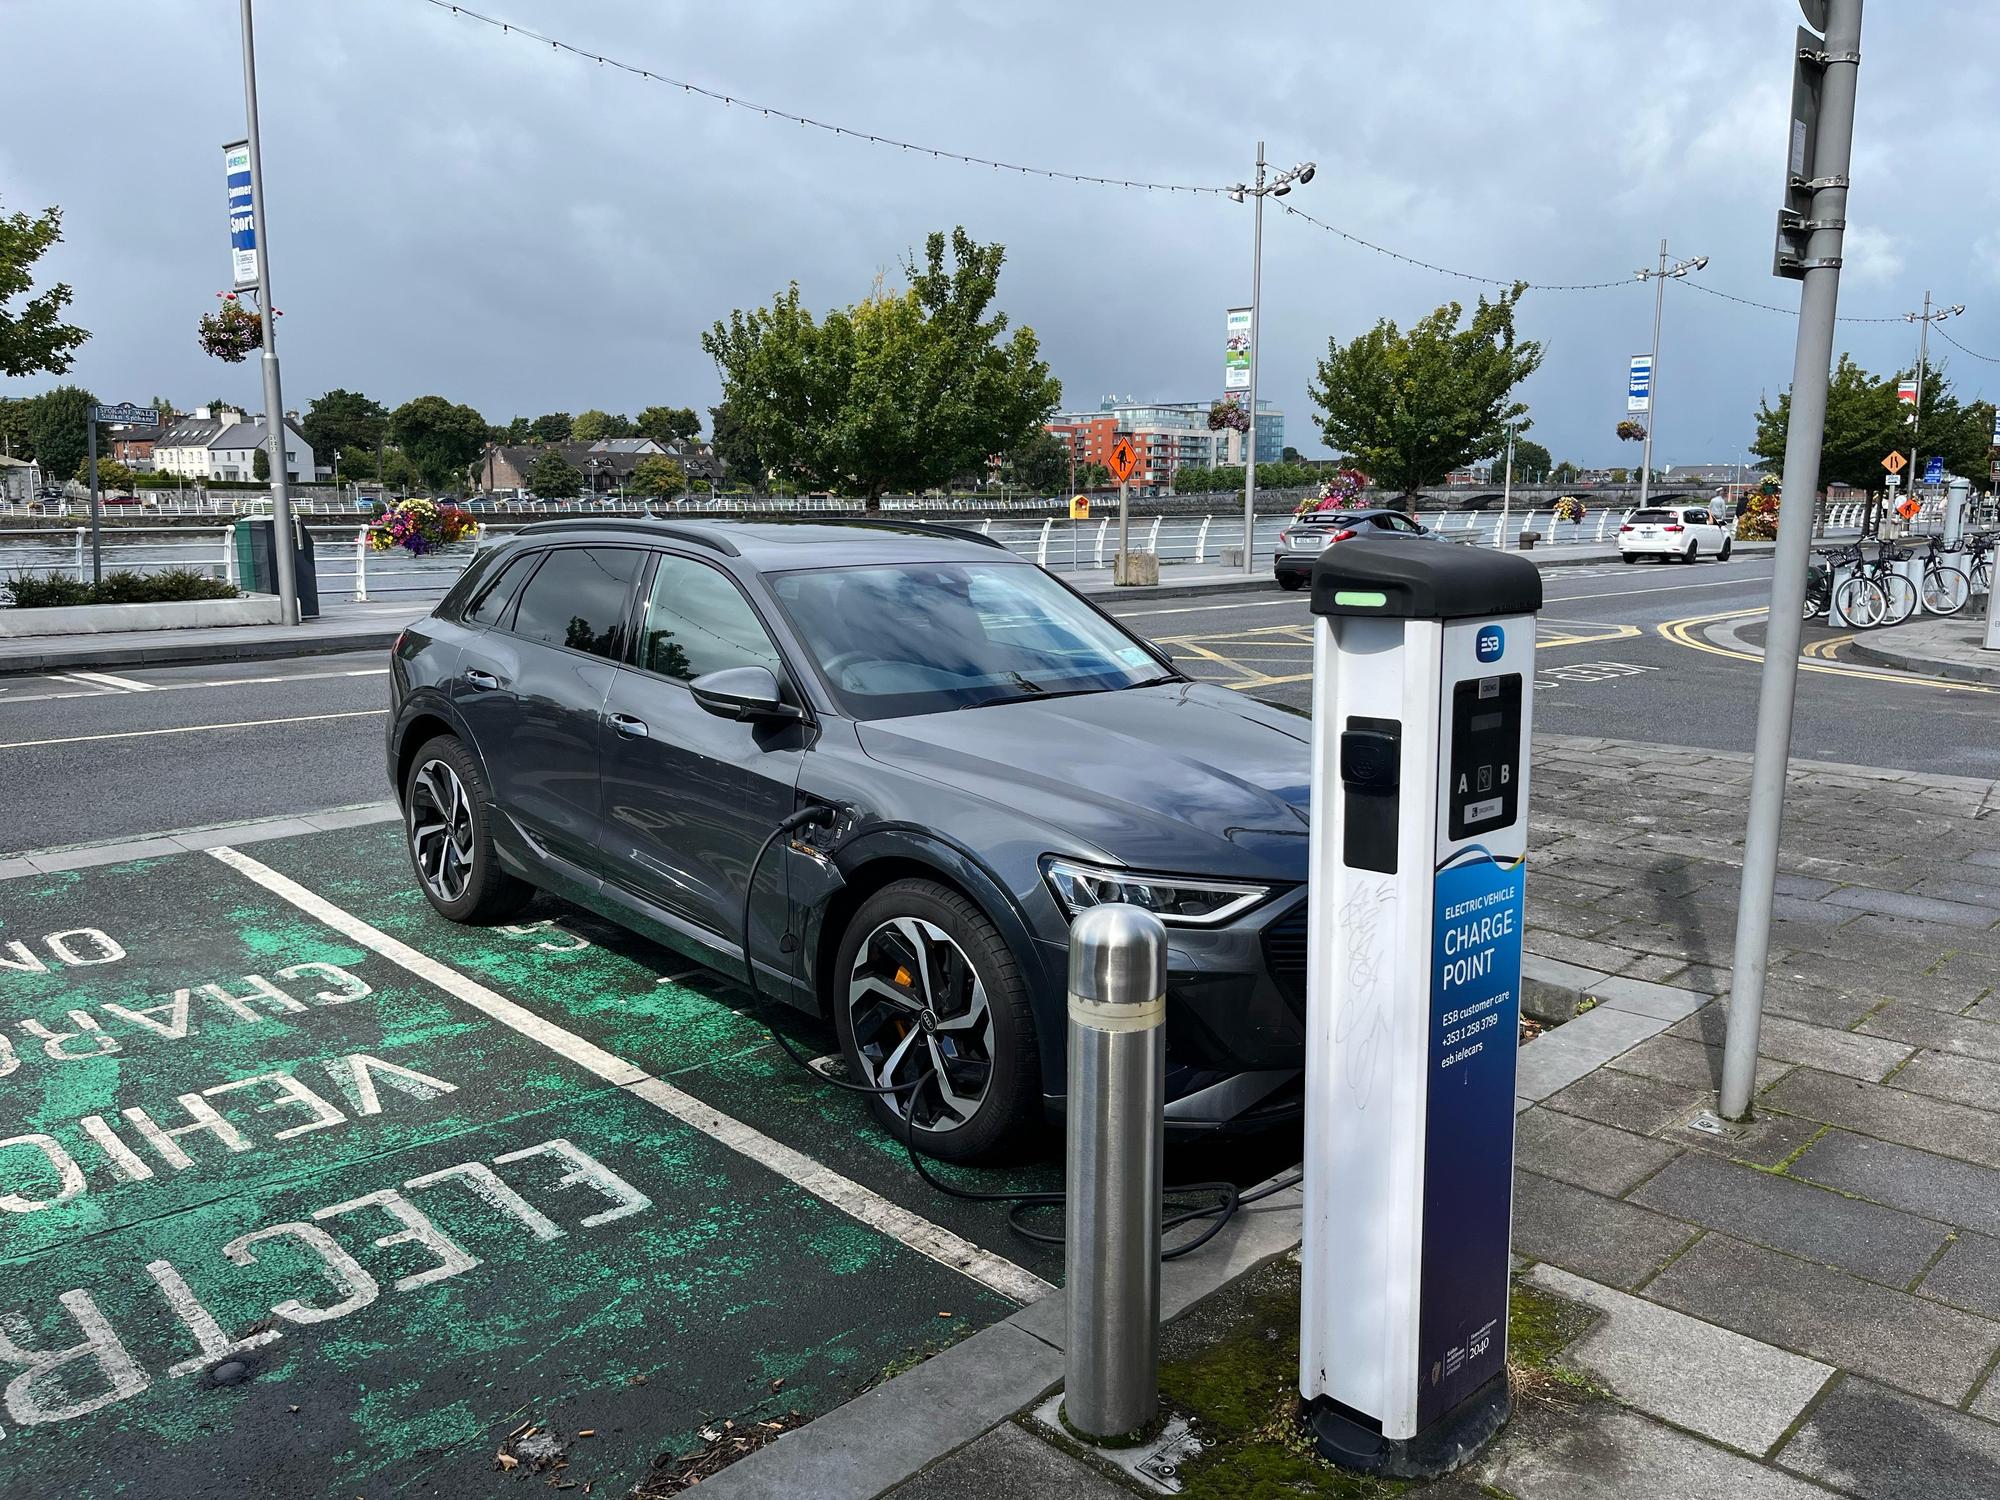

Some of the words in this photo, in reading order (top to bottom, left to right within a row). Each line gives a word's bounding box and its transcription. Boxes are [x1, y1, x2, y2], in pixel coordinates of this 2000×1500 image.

[231, 215, 254, 234] Sport
[1481, 636, 1499, 652] ESB
[1458, 774, 1468, 794] A
[1500, 764, 1510, 784] B
[1445, 896, 1483, 920] ELECTRIC
[1483, 886, 1515, 907] VEHICLE
[1444, 909, 1513, 956] CHARGE
[1443, 948, 1495, 991] POINT
[0, 962, 373, 1077] CHAR
[1442, 1010, 1459, 1027] ESB
[1459, 998, 1494, 1019] customer
[1494, 990, 1510, 1005] care
[1442, 1031, 1460, 1046] +353
[1461, 1027, 1466, 1040] 1
[1466, 1021, 1481, 1038] 258
[1481, 1013, 1498, 1032] 3799
[1441, 1041, 1483, 1069] esb.ie/ecars
[0, 1138, 653, 1439] ELECTR
[1469, 1337, 1490, 1360] 2040
